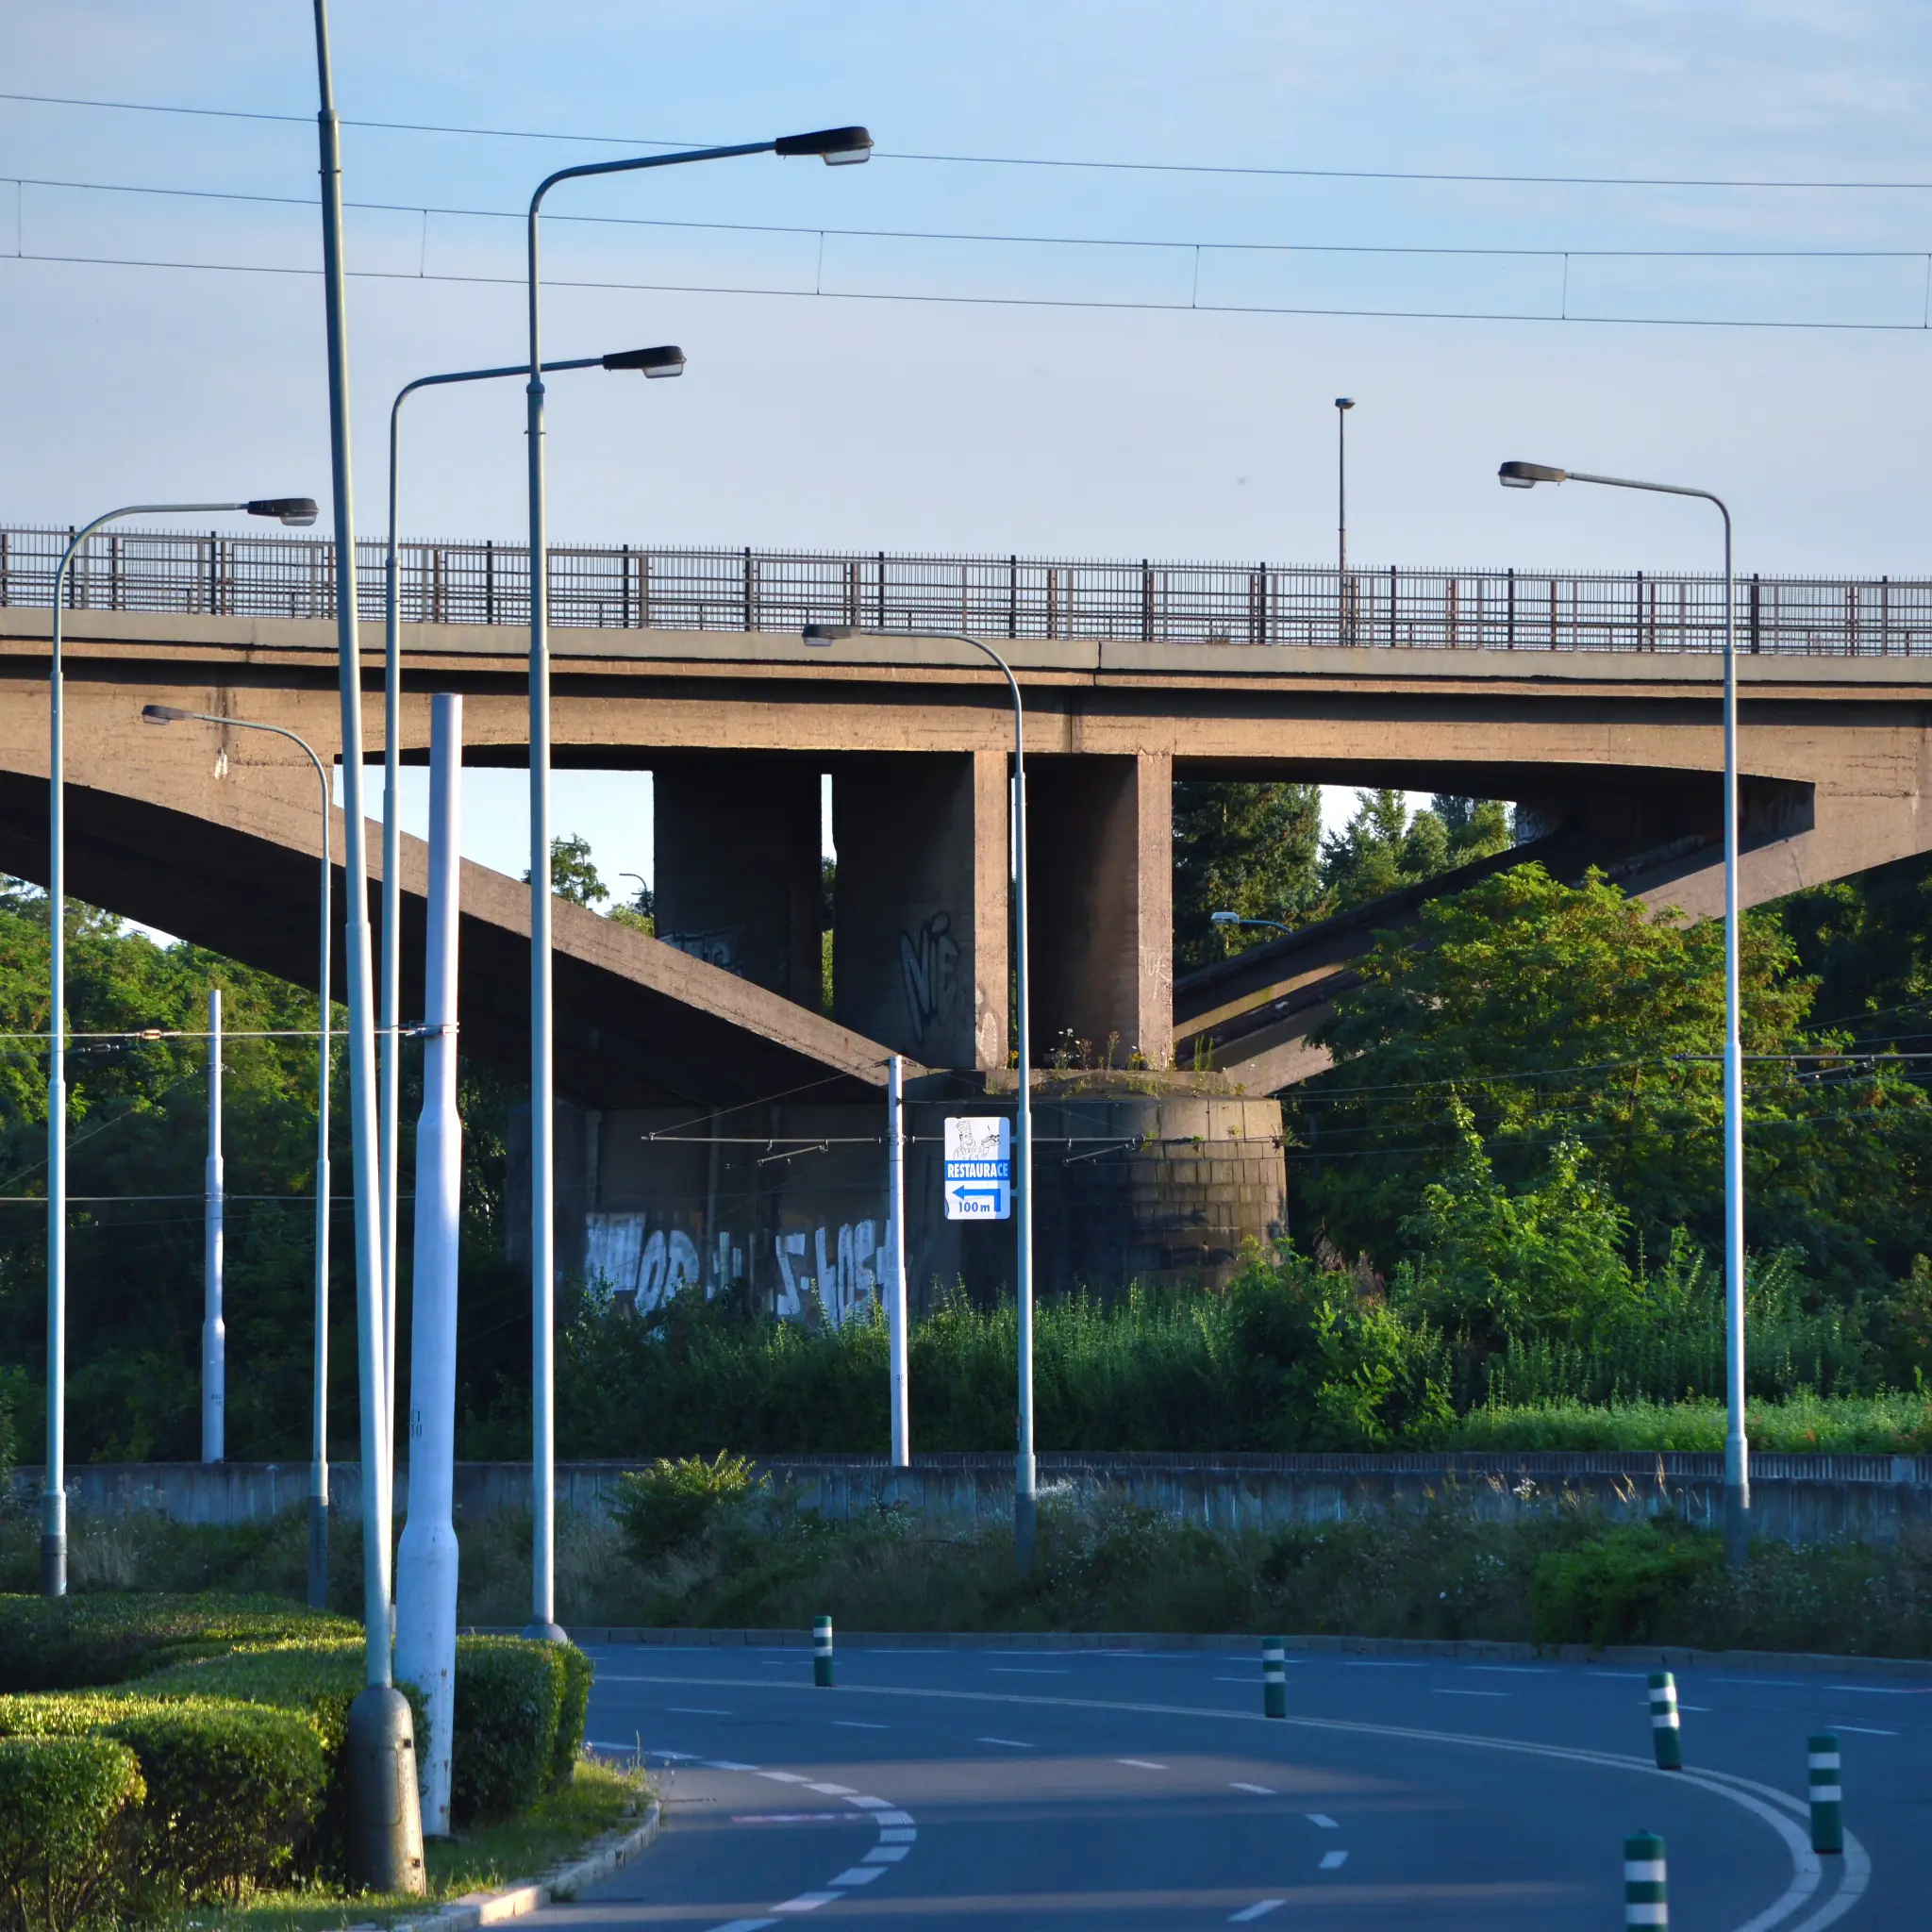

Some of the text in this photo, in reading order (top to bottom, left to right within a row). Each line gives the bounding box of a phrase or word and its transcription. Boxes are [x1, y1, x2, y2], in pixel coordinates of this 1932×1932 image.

[947, 1162, 1008, 1178] RESTAURACE
[958, 1201, 991, 1212] 100 m
